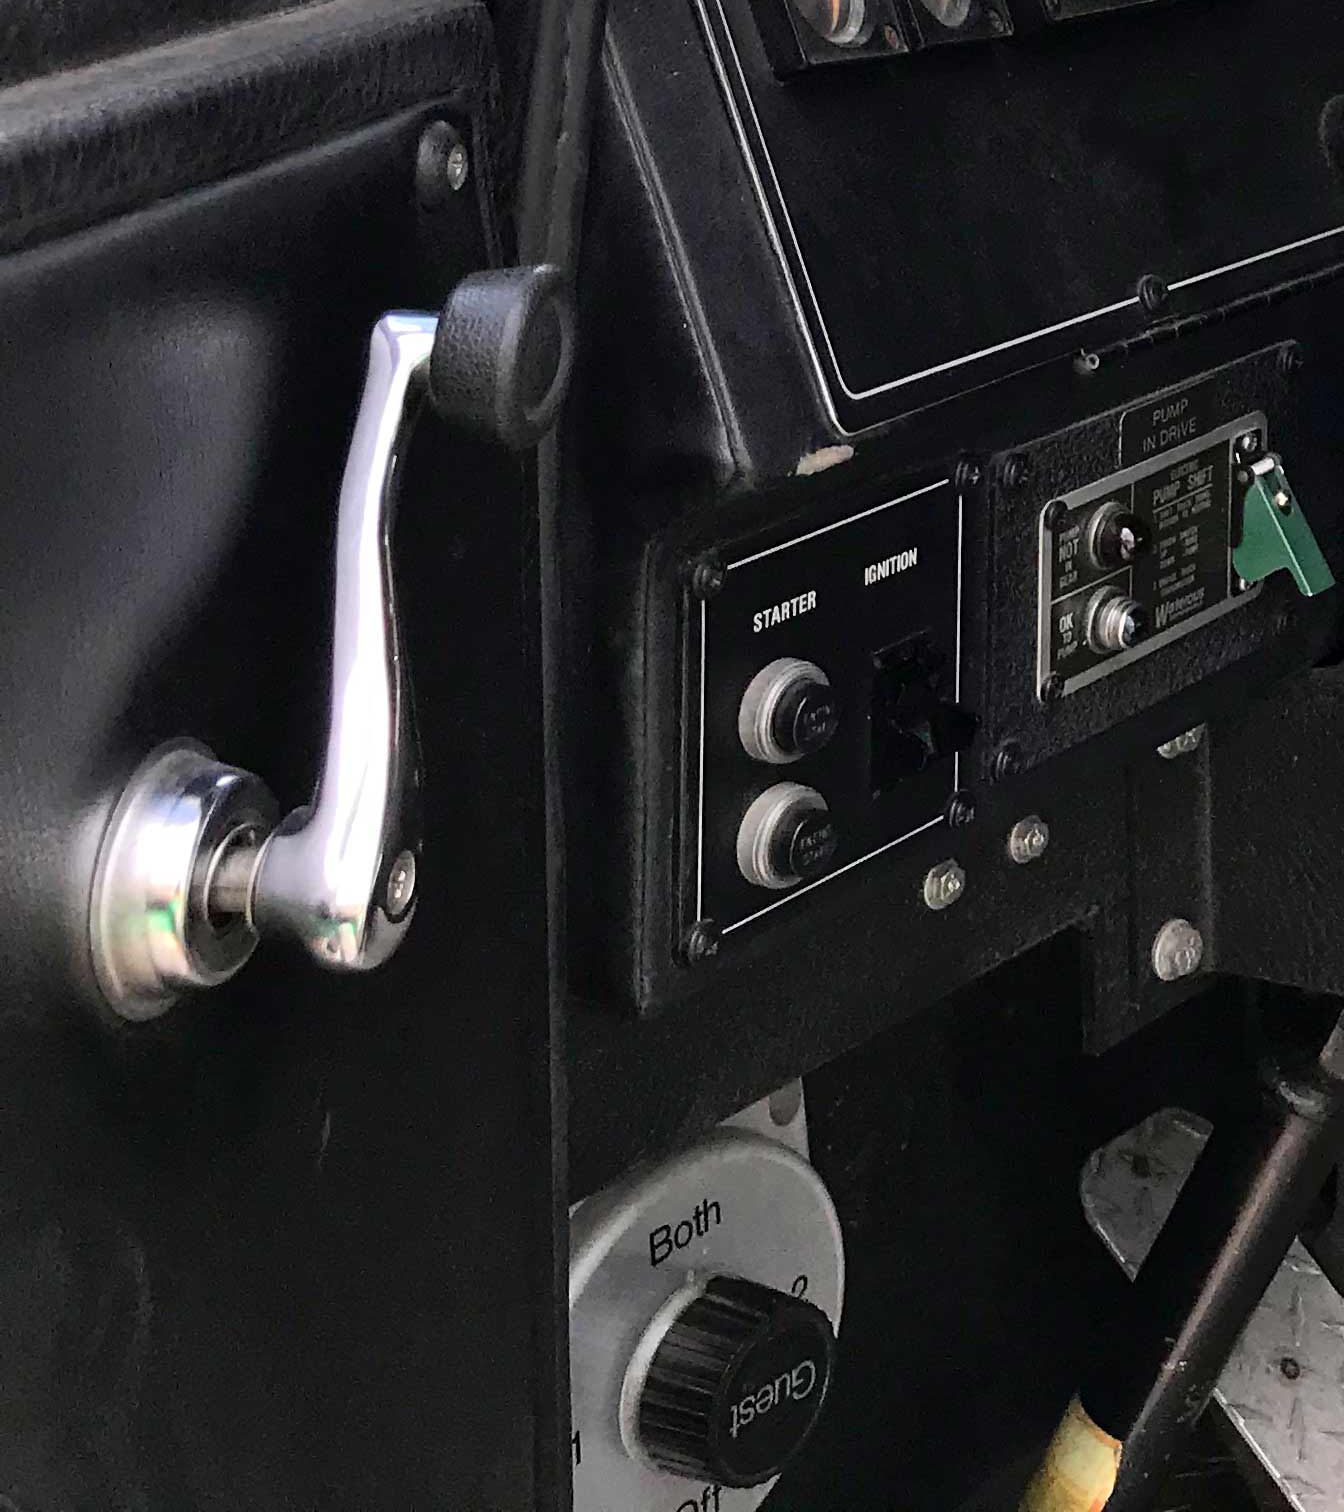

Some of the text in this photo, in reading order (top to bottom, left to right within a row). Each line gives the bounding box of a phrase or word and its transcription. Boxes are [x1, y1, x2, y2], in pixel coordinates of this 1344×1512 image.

[1153, 399, 1188, 426] PUMP
[1143, 416, 1197, 452] IN DRIVE
[1153, 464, 1214, 506] PUMP SHIFT
[864, 547, 917, 586] IGNITION
[1060, 538, 1079, 562] NOT
[753, 590, 817, 633] STARTER
[1060, 612, 1074, 633] OK
[650, 1198, 721, 1267] Both
[791, 1274, 808, 1299] 2
[728, 1360, 816, 1439] Guest
[572, 1430, 581, 1465] 1
